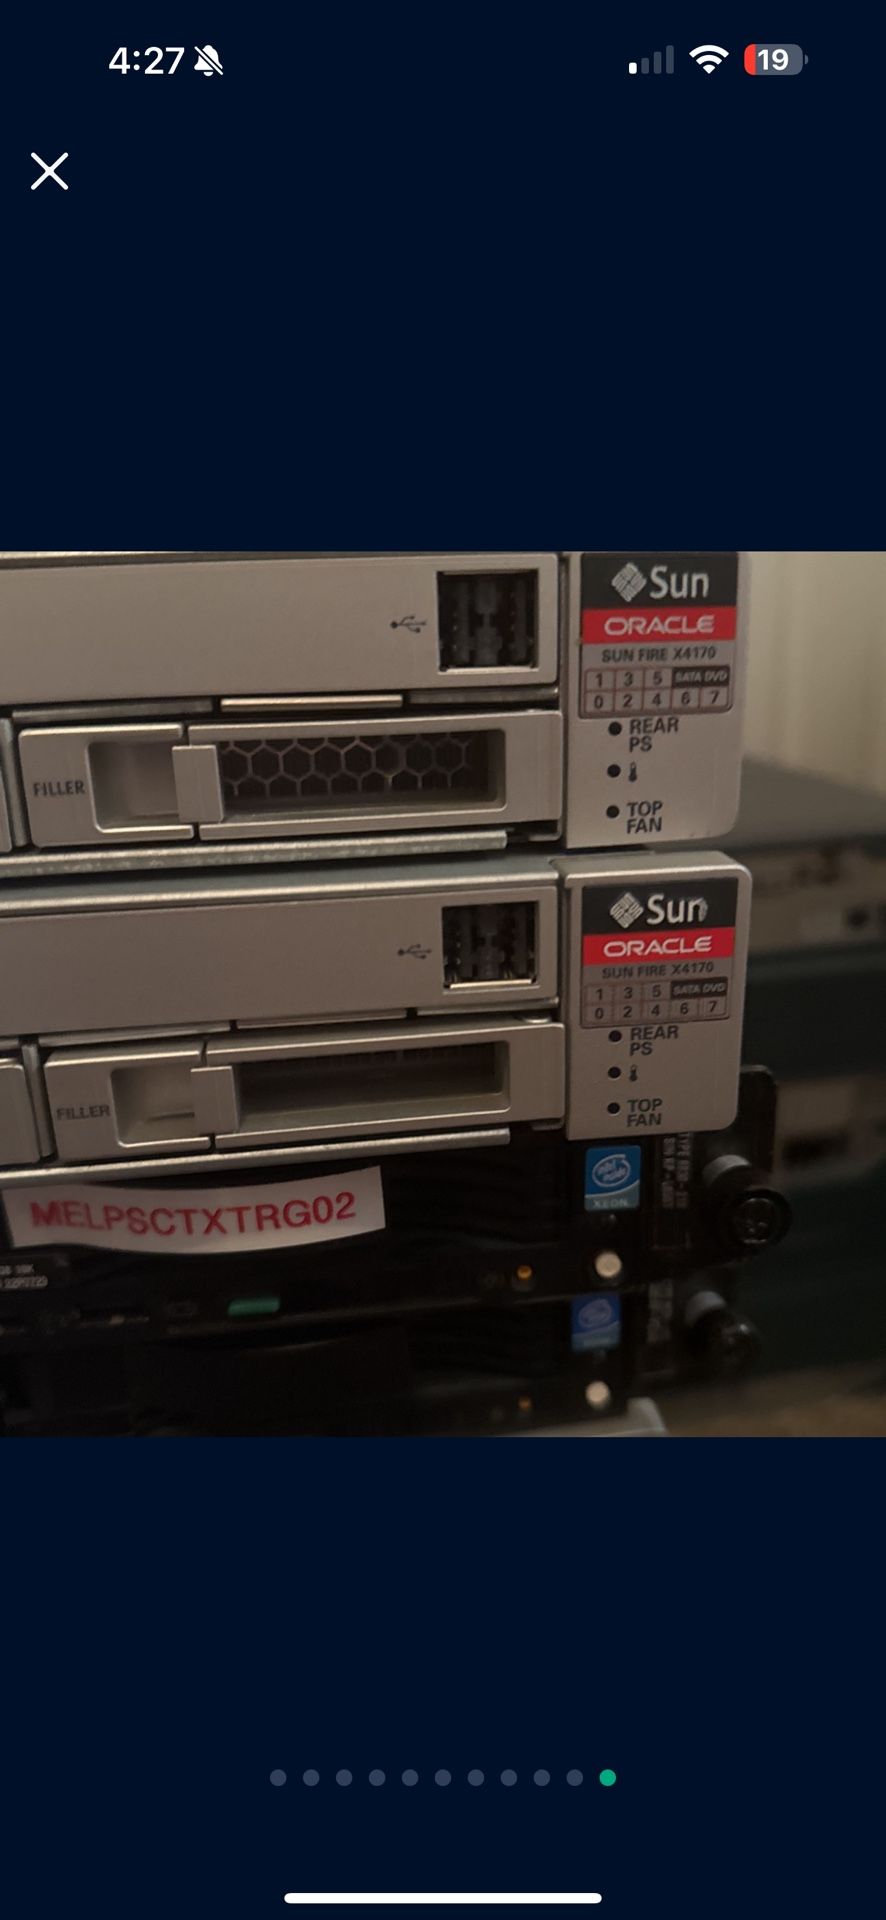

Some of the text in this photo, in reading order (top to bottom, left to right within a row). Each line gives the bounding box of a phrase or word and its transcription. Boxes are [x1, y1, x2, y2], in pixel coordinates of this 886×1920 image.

[649, 565, 710, 599] Sun
[604, 615, 716, 636] ORACLE
[601, 646, 718, 663] SUN FIRE X4170
[595, 670, 728, 687] 1 3 5 SATA DVD
[594, 690, 720, 709] 0 2 4 6 7
[629, 717, 679, 734] REAR
[628, 735, 653, 752] PS
[33, 780, 85, 797] FILLER
[626, 801, 663, 817] TOP
[626, 817, 663, 834] FAN
[646, 893, 709, 926] Sun
[603, 935, 713, 958] ORACLE
[602, 962, 715, 979] SUN FIRE X4170
[595, 983, 726, 1000] 1 3 5 SATA DVD
[595, 1001, 718, 1020] 0 2 4 6 7
[630, 1025, 679, 1041] REAR
[629, 1041, 653, 1056] PS
[56, 1104, 111, 1121] FILLER
[626, 1098, 663, 1113] TOP
[626, 1112, 662, 1128] FAN
[592, 1197, 629, 1208] XEON
[29, 1191, 358, 1237] MELPSCTXTRG02
